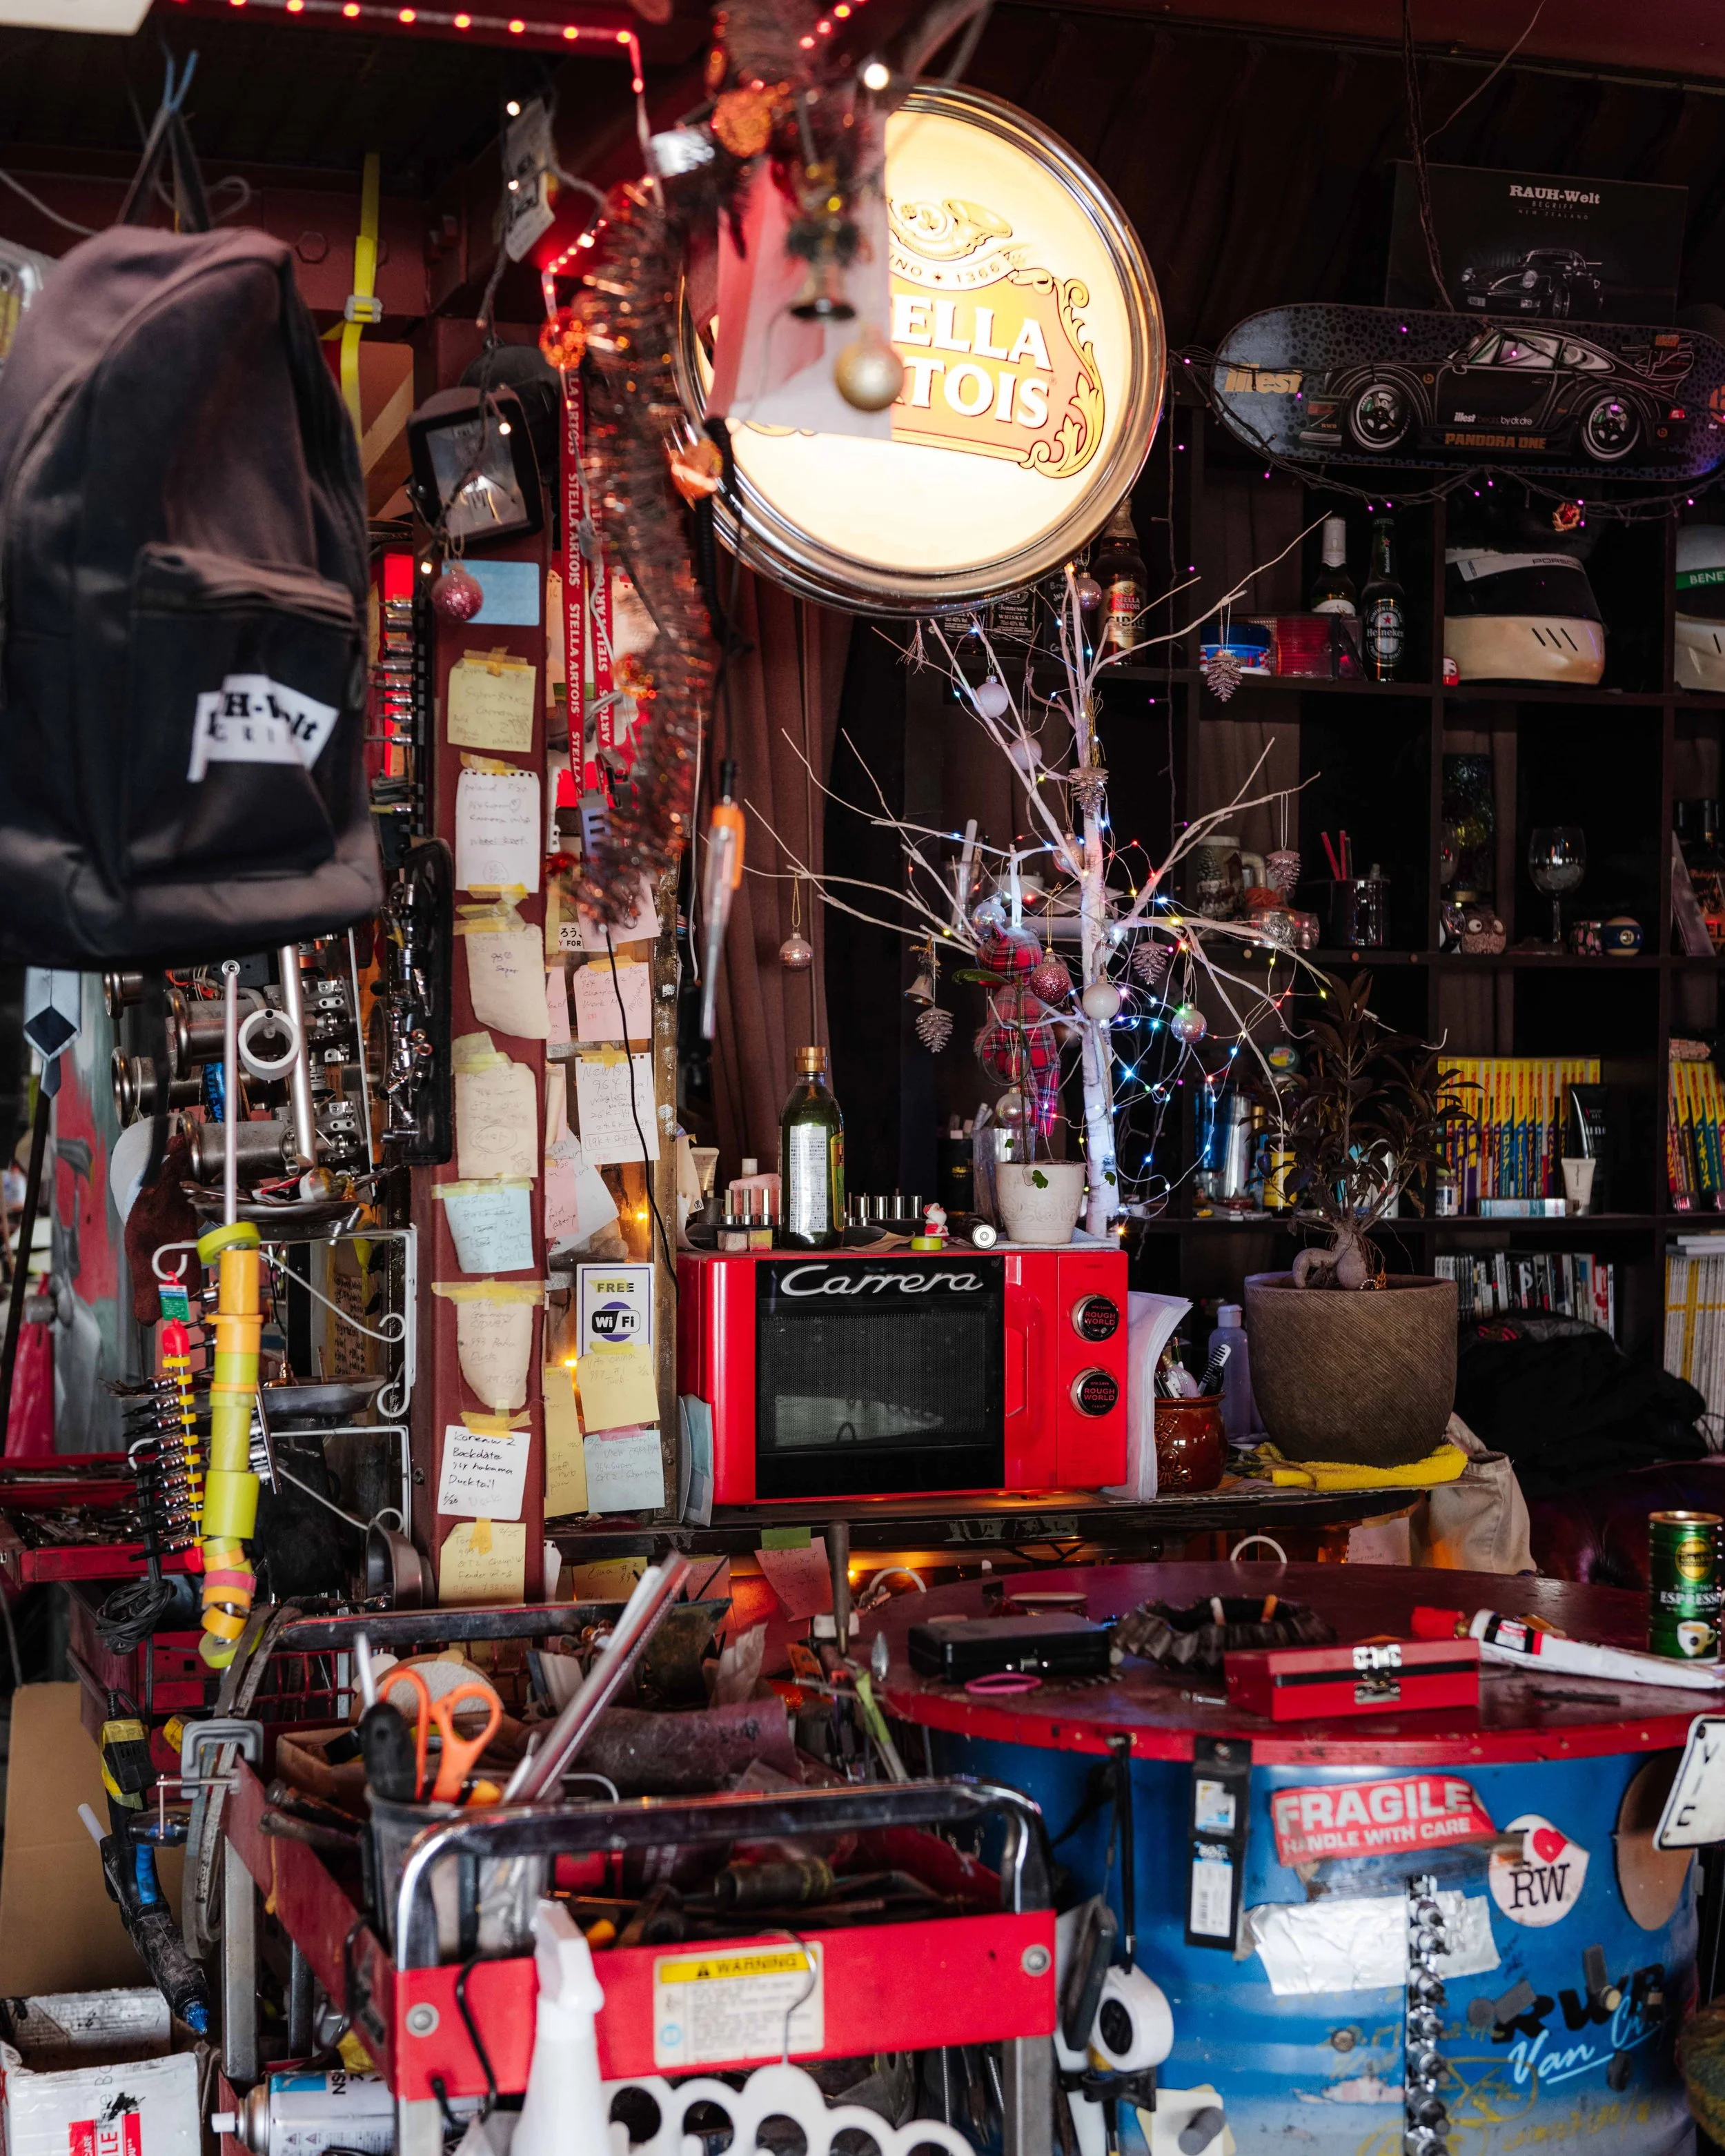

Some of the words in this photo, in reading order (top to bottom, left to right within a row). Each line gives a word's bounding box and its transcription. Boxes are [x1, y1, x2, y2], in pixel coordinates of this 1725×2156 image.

[1509, 184, 1601, 204] RAUH-Welt
[1531, 200, 1574, 210] BEGRIFF
[1544, 211, 1589, 221] ZEALAND
[956, 261, 1000, 284] 1366
[889, 293, 1054, 373] ELLA
[897, 355, 1050, 430] TOIS
[1444, 432, 1516, 448] PANDORA
[1517, 435, 1548, 451] ONE
[568, 530, 581, 587] ARTOIS
[1689, 570, 1725, 586] BENE
[569, 602, 581, 657] STELLA
[1366, 627, 1405, 637] Heineken
[569, 659, 581, 714] ARTOIS
[597, 1283, 635, 1293] FREE
[780, 1264, 985, 1298] Carrera
[1085, 1311, 1116, 1319] ROUGH
[1085, 1318, 1116, 1326] WORLD
[1659, 1590, 1721, 1606] ESPRESS
[1276, 1781, 1473, 1835] FRAGILE
[1282, 1829, 1359, 1856] HANDLE
[1363, 1826, 1417, 1846] WITH
[1419, 1817, 1471, 1839] CARE
[1508, 1863, 1572, 1910] RW
[716, 1953, 798, 1974] WARNING
[1508, 2029, 1597, 2084] Van
